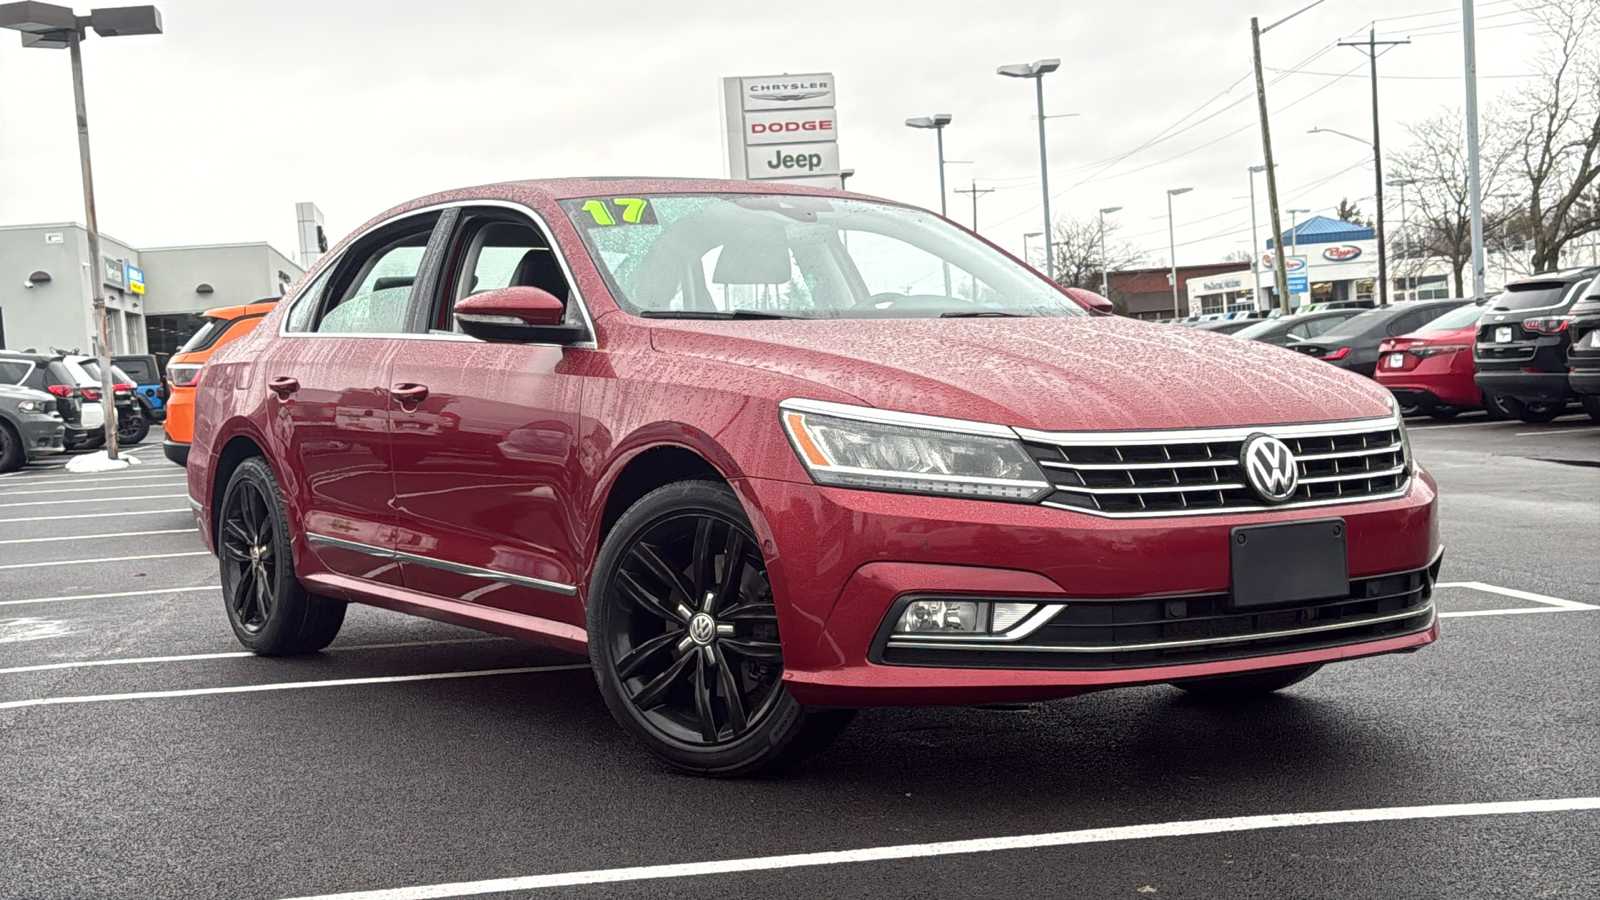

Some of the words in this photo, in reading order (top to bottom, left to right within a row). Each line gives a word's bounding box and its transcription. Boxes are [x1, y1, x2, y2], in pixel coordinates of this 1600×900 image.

[750, 82, 828, 92] CHRYSLER
[751, 120, 833, 134] DODGE
[767, 149, 822, 172] Jeep
[581, 198, 648, 226] 17
